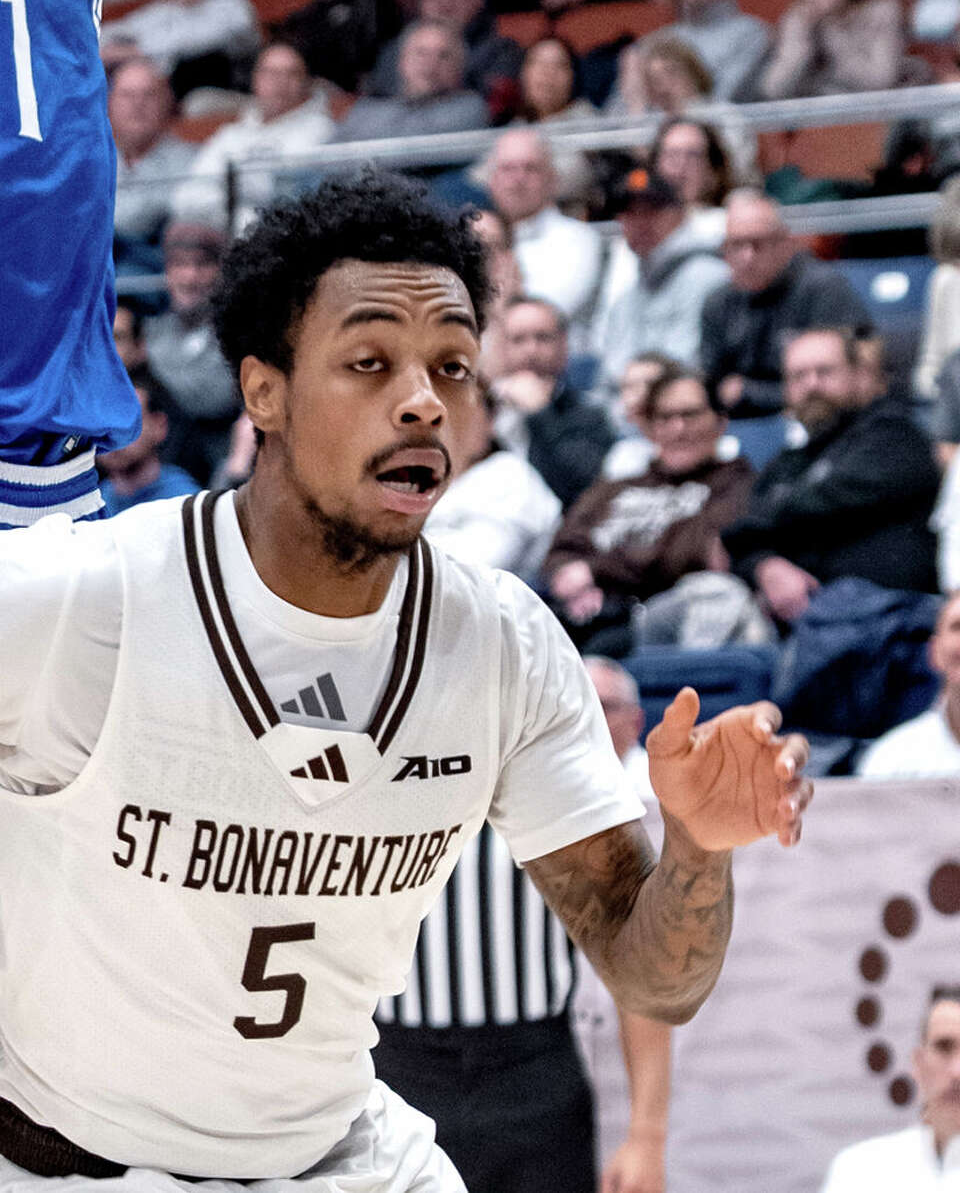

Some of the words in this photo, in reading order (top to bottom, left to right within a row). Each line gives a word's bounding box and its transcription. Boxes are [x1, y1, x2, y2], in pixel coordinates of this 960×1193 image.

[390, 754, 472, 782] A10
[112, 803, 172, 884] ST.
[182, 819, 463, 896] BONAVENTURE
[233, 922, 316, 1040] 5
